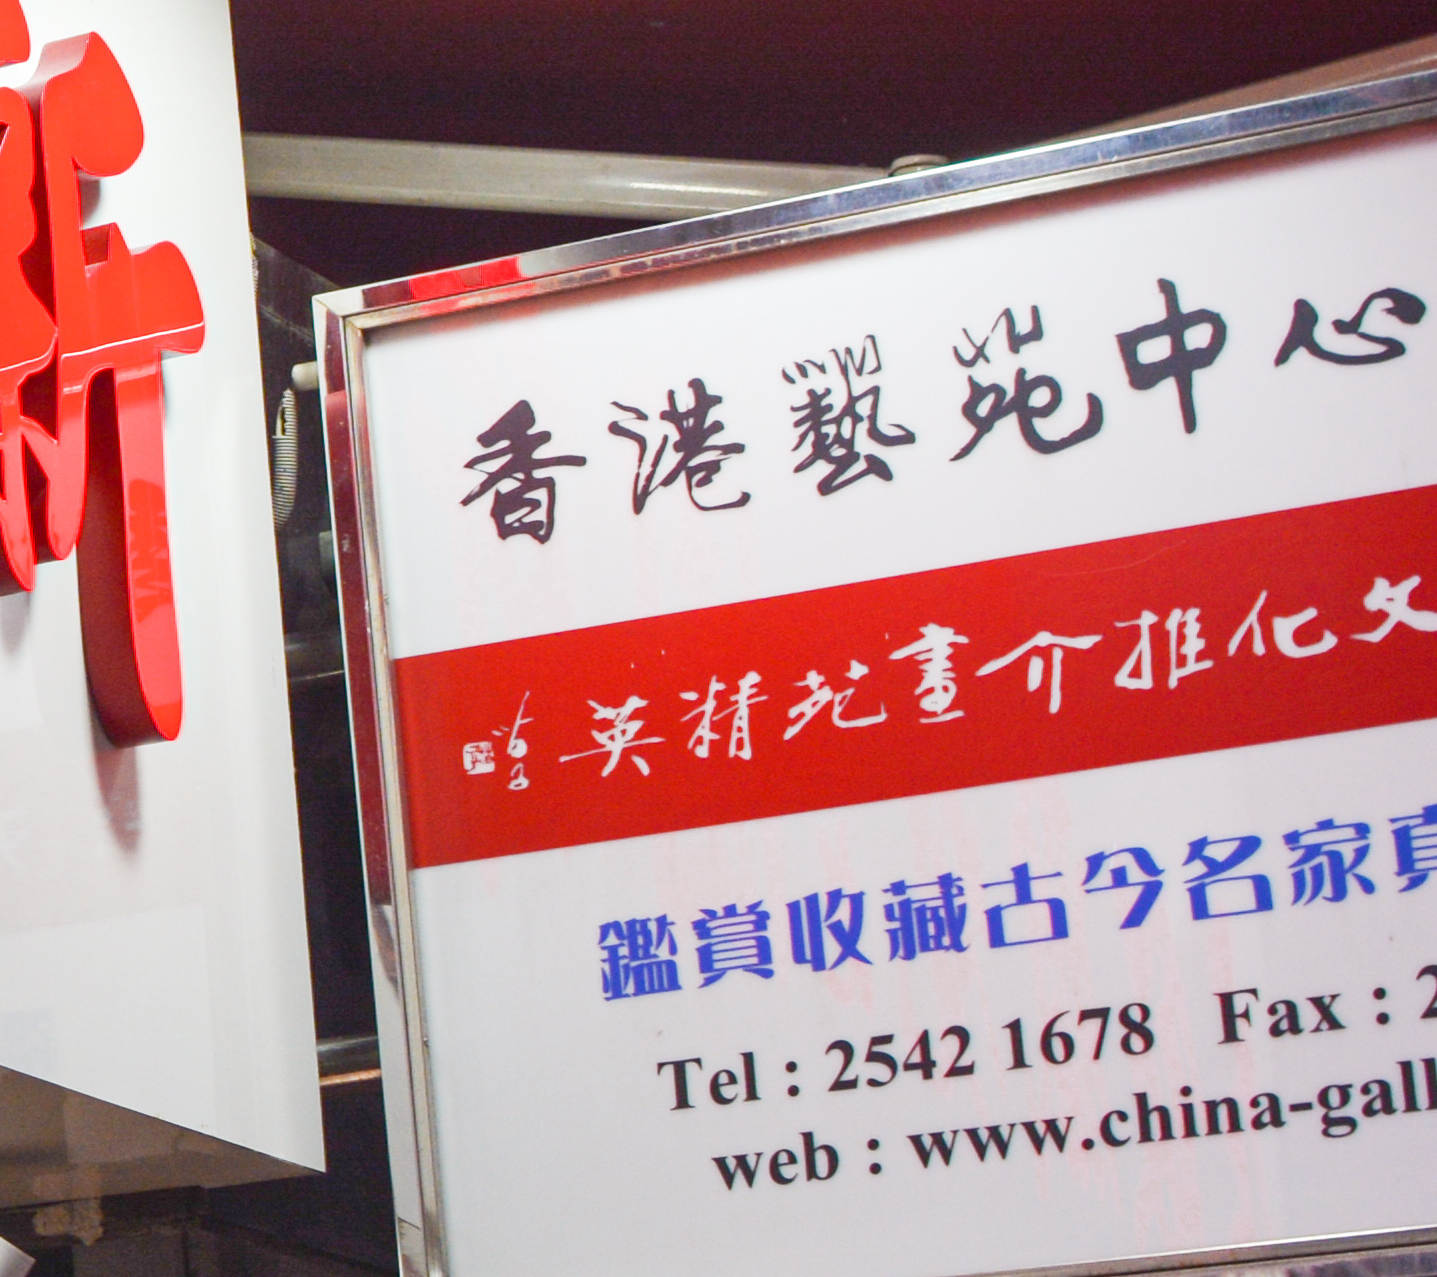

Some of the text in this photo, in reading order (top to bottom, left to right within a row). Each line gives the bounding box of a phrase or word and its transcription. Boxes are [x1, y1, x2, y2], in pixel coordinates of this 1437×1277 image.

[823, 1024, 976, 1093] 2542
[1001, 1001, 1156, 1071] 1678
[905, 1057, 1437, 1171] www.china-gall
